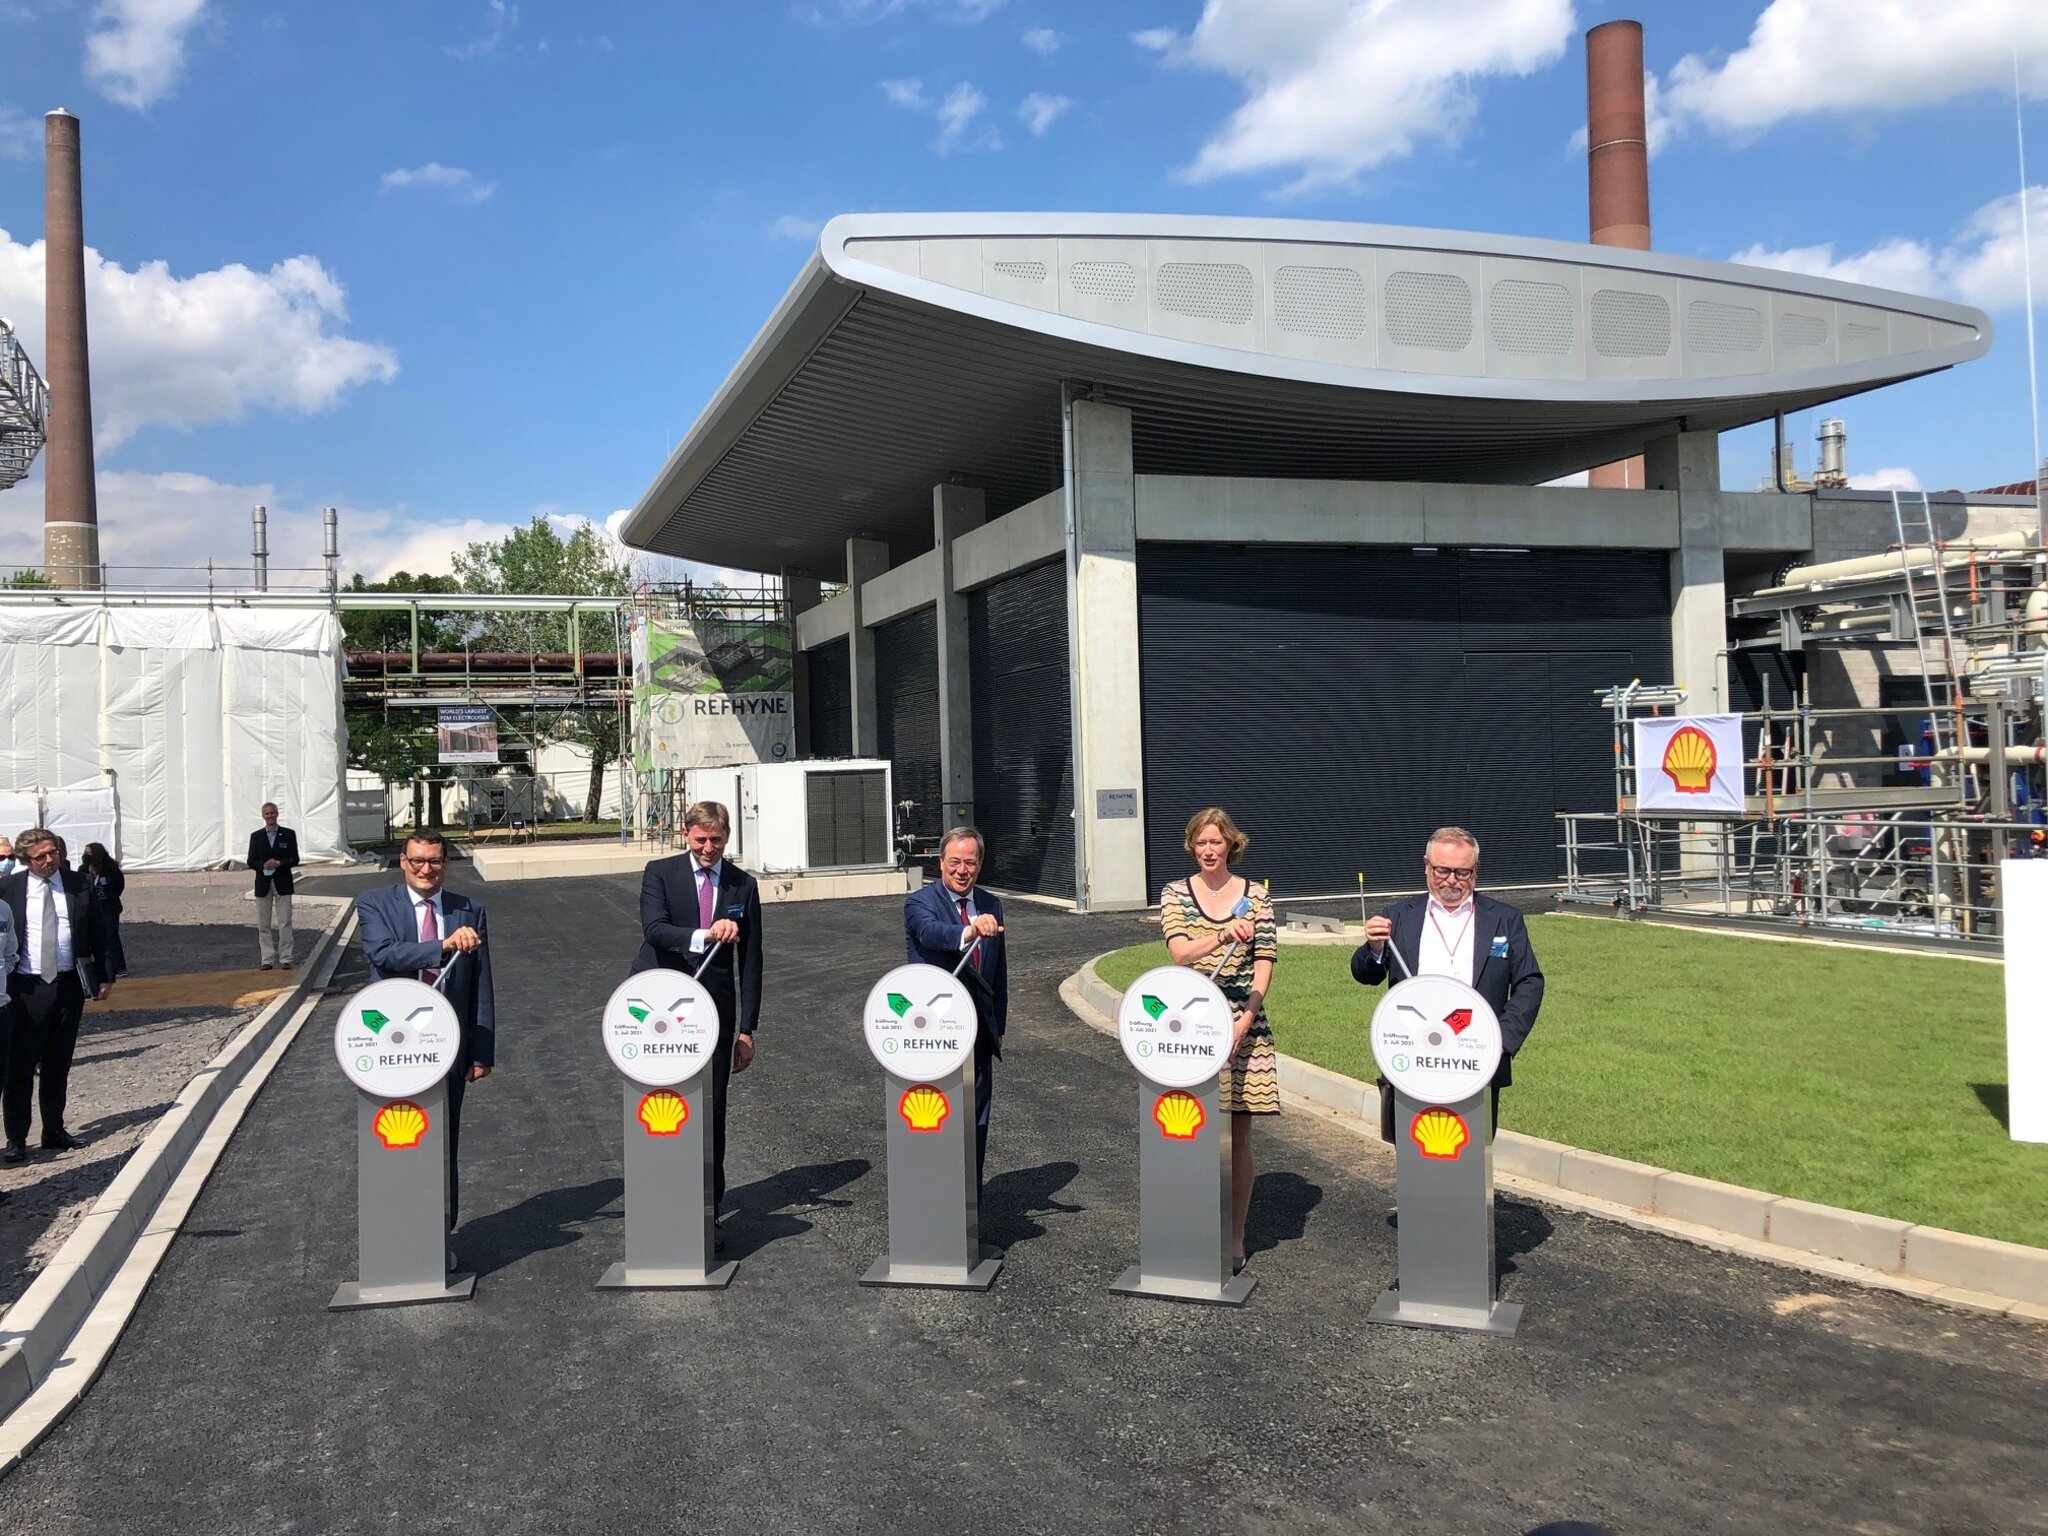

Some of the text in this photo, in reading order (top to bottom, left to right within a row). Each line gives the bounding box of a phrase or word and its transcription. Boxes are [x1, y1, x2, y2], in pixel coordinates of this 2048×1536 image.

[694, 698, 787, 715] REFHYNE
[895, 998, 909, 1011] ON
[1150, 1001, 1163, 1013] ON
[370, 1014, 385, 1028] ON
[1451, 1013, 1468, 1030] OFF
[644, 1043, 700, 1054] REFHYNE
[904, 1039, 959, 1049] REFHYNE
[1158, 1043, 1215, 1056] REFHYNE
[379, 1052, 440, 1066] REFHYNE
[1416, 1056, 1480, 1071] REFHYNE
